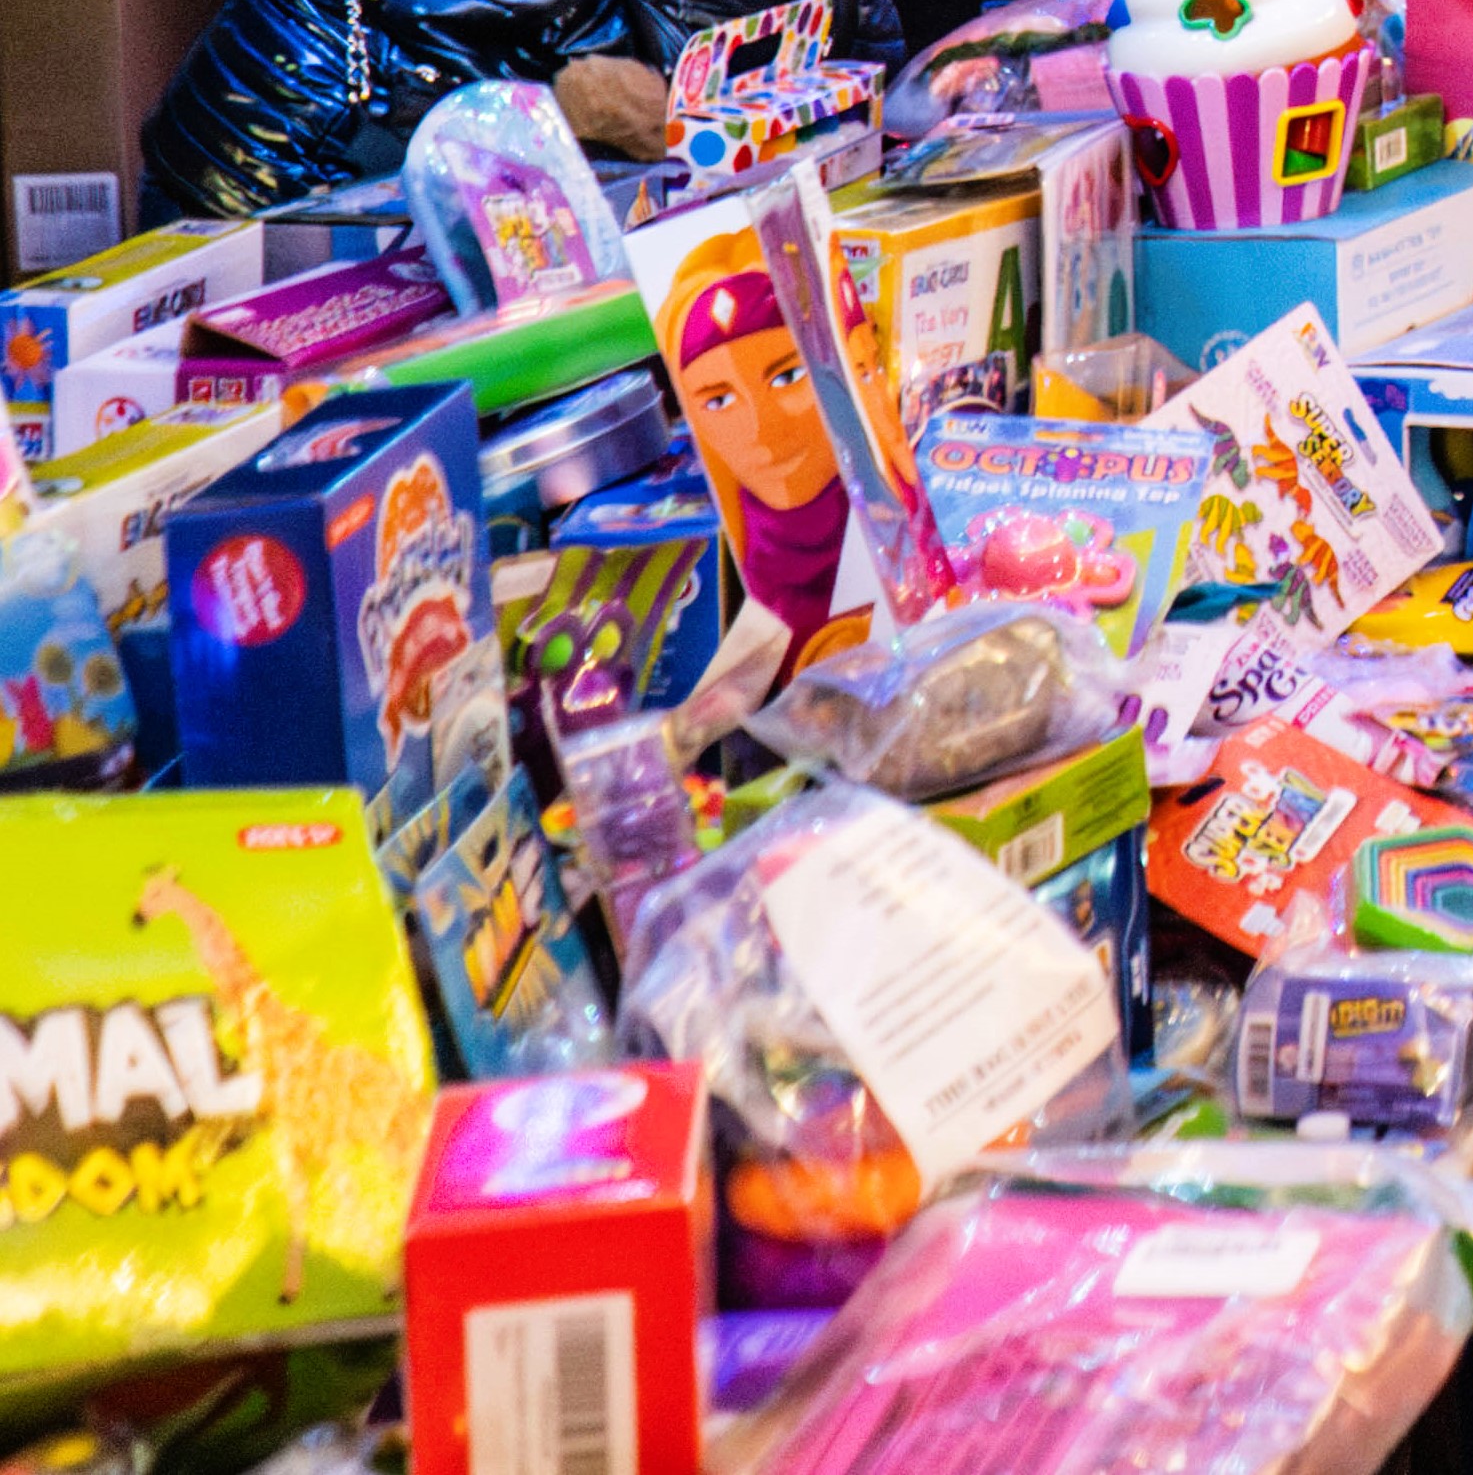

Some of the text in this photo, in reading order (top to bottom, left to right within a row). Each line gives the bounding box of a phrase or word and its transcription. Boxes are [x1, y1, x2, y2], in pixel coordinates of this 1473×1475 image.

[1289, 390, 1354, 468] SUPER
[1019, 478, 1128, 502] Spinning
[1137, 484, 1182, 504] Top
[1208, 648, 1282, 723] Spa
[1185, 793, 1272, 880] SUPER
